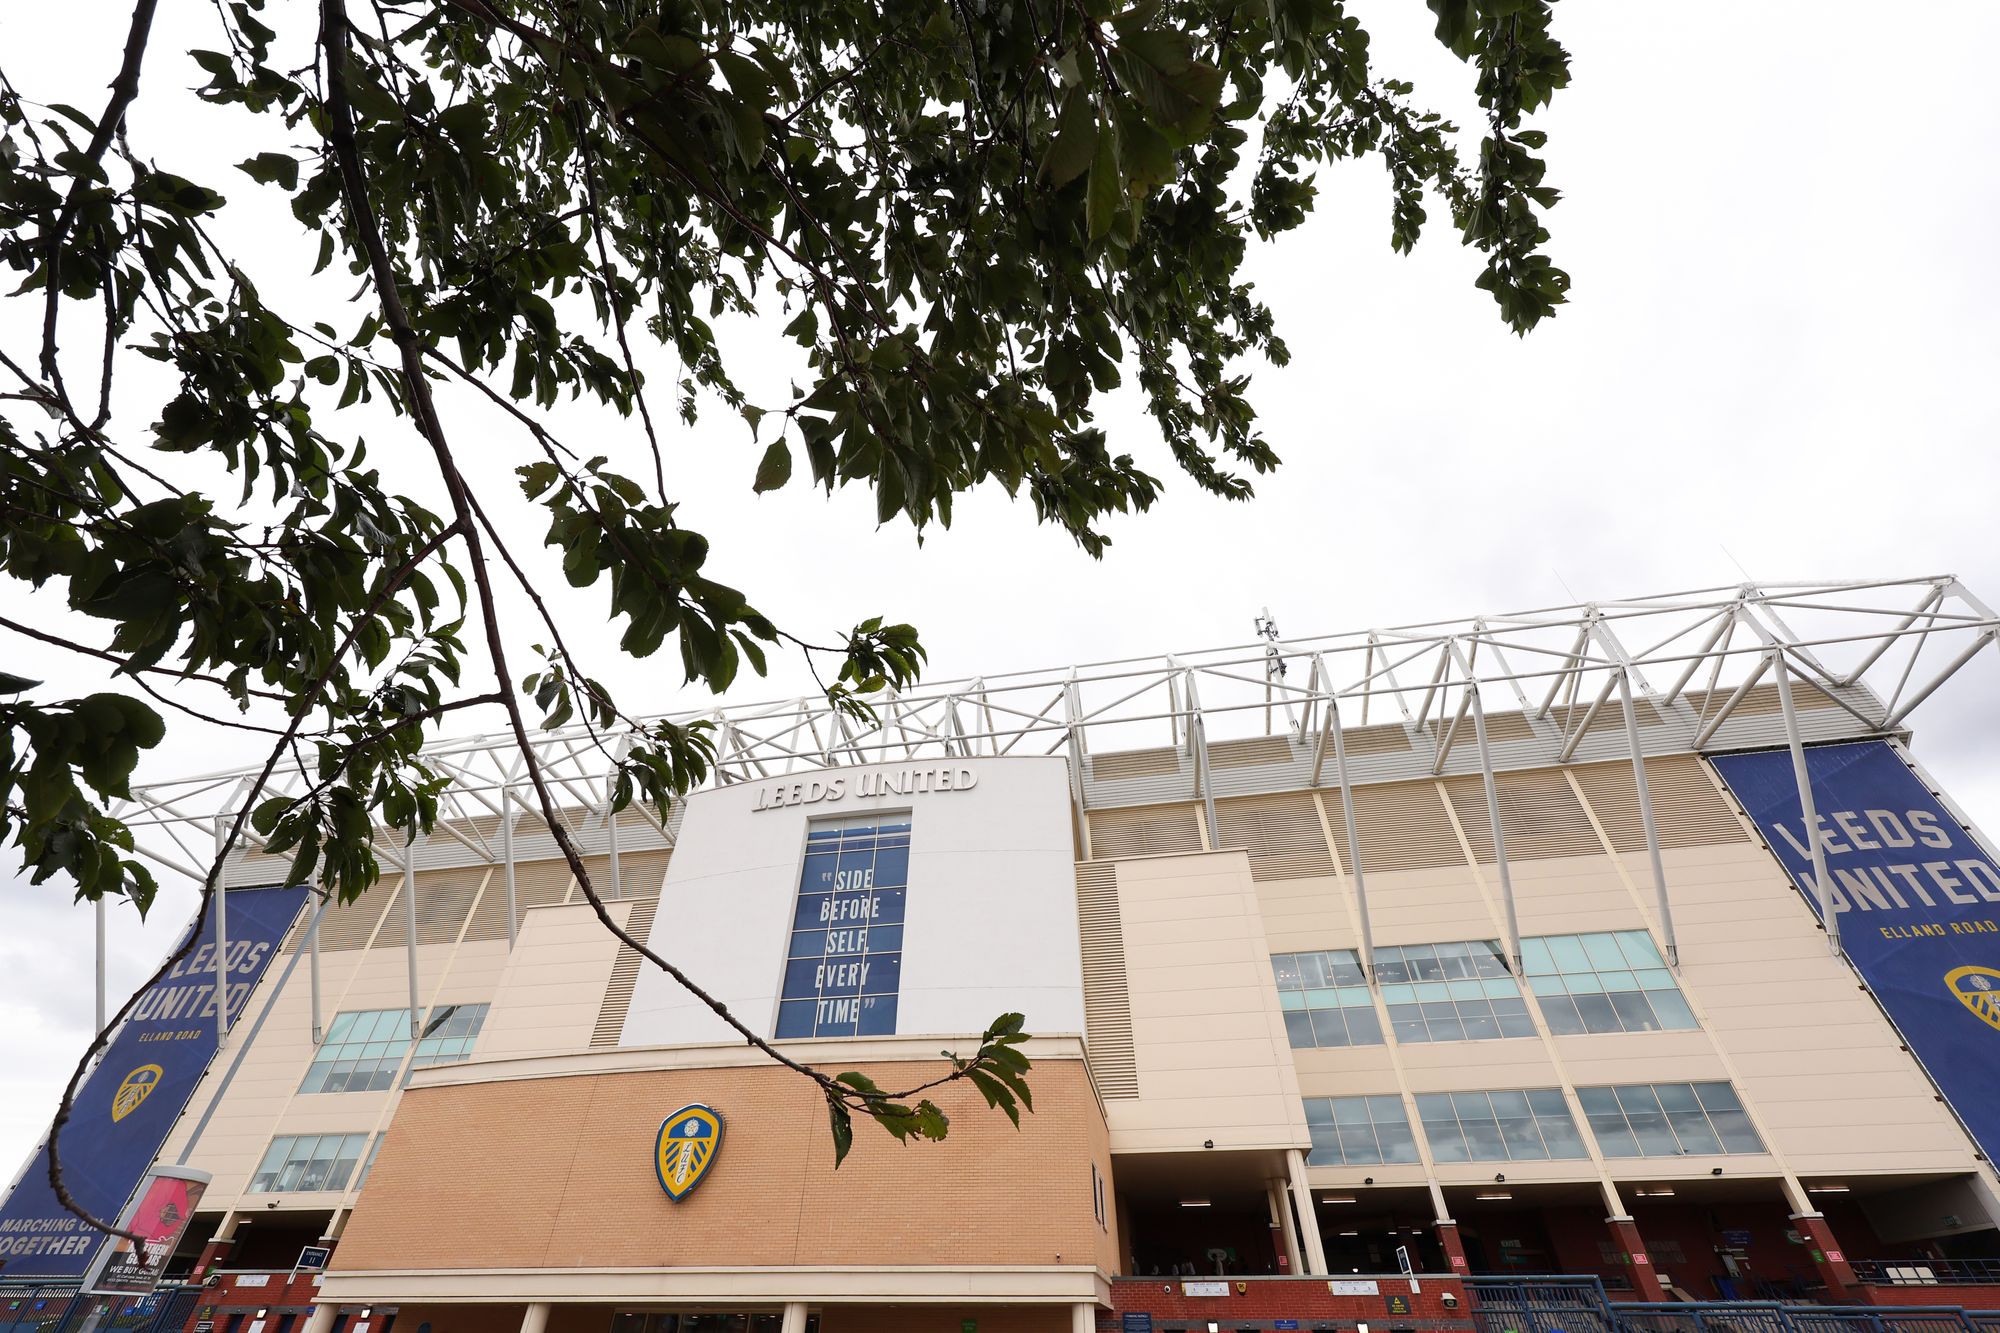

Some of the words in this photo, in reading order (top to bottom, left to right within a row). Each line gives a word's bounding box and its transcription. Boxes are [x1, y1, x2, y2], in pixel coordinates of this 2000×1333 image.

[751, 777, 845, 812] LEEDS
[855, 767, 979, 797] UNITED
[819, 897, 881, 922] BEFORE
[1879, 923, 1946, 940] ELLAND
[1949, 920, 1999, 935] ROAD
[814, 962, 871, 989] EVERY
[138, 1031, 173, 1043] ELLAND
[175, 1029, 202, 1041] ROAD
[0, 1218, 77, 1233] MARCHING
[0, 1235, 92, 1255] OGETHER
[109, 1265, 123, 1274] WE
[123, 1266, 139, 1274] BUY
